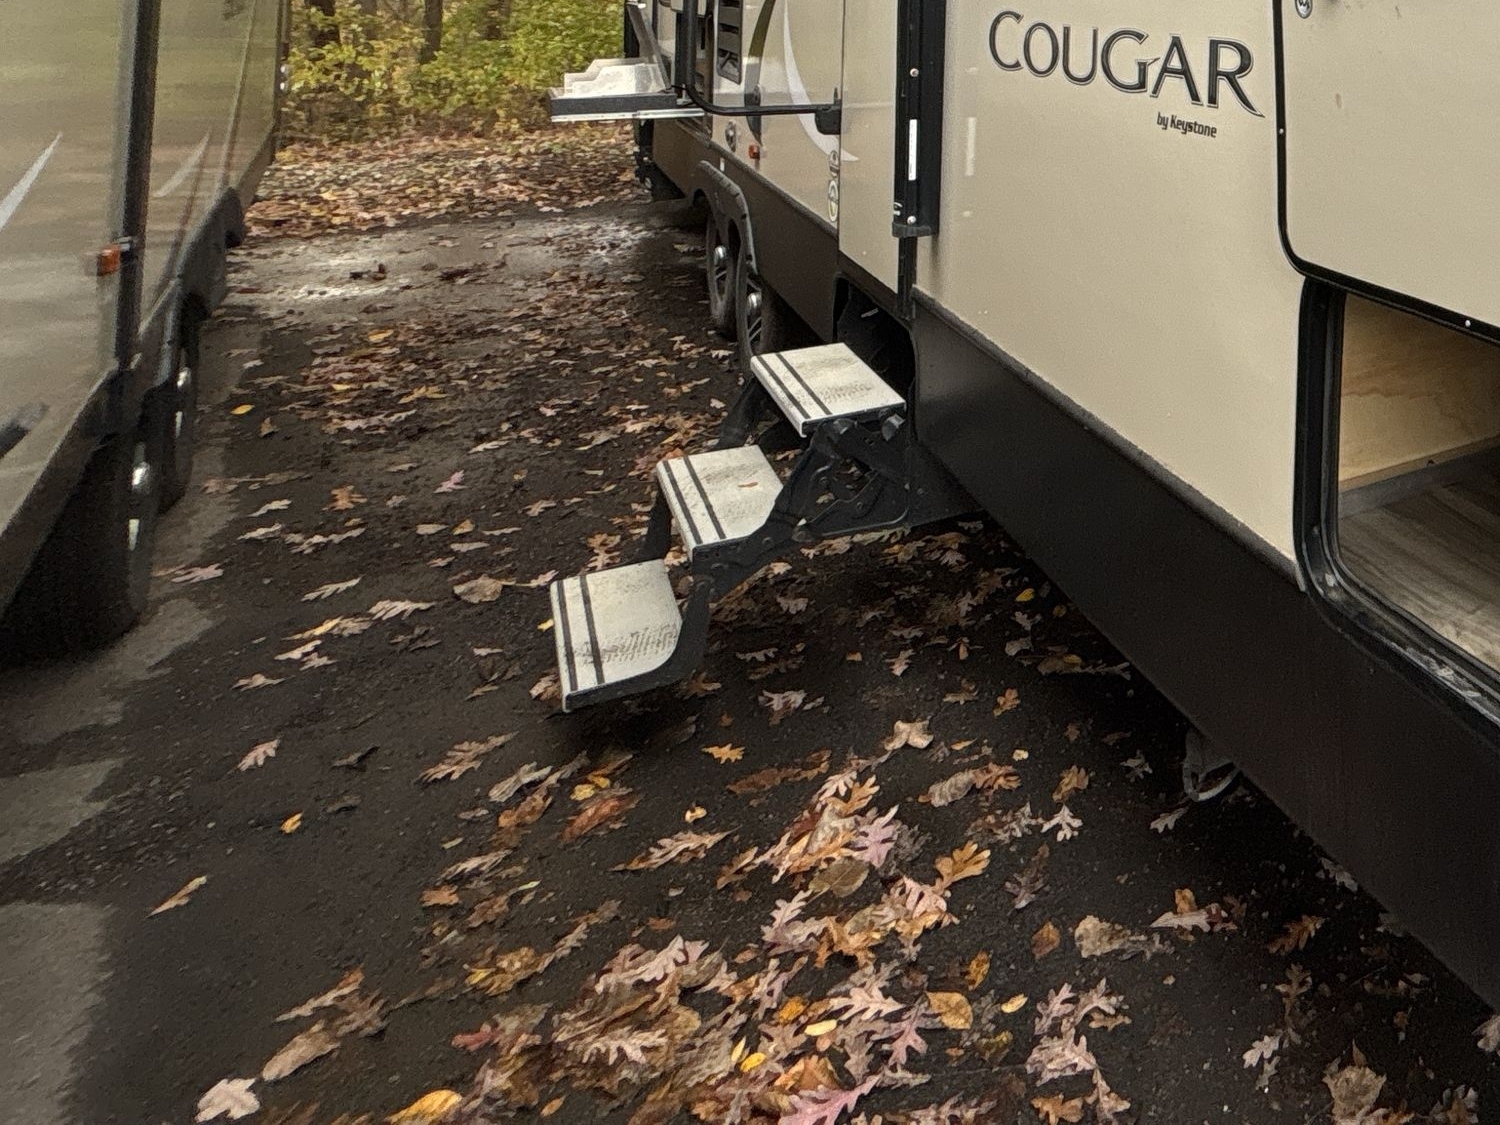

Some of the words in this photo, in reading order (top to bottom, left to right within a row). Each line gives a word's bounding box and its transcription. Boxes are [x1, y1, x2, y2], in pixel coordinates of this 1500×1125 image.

[988, 10, 1265, 118] COUGAR
[1157, 111, 1169, 130] by
[1170, 114, 1217, 138] Keystone
